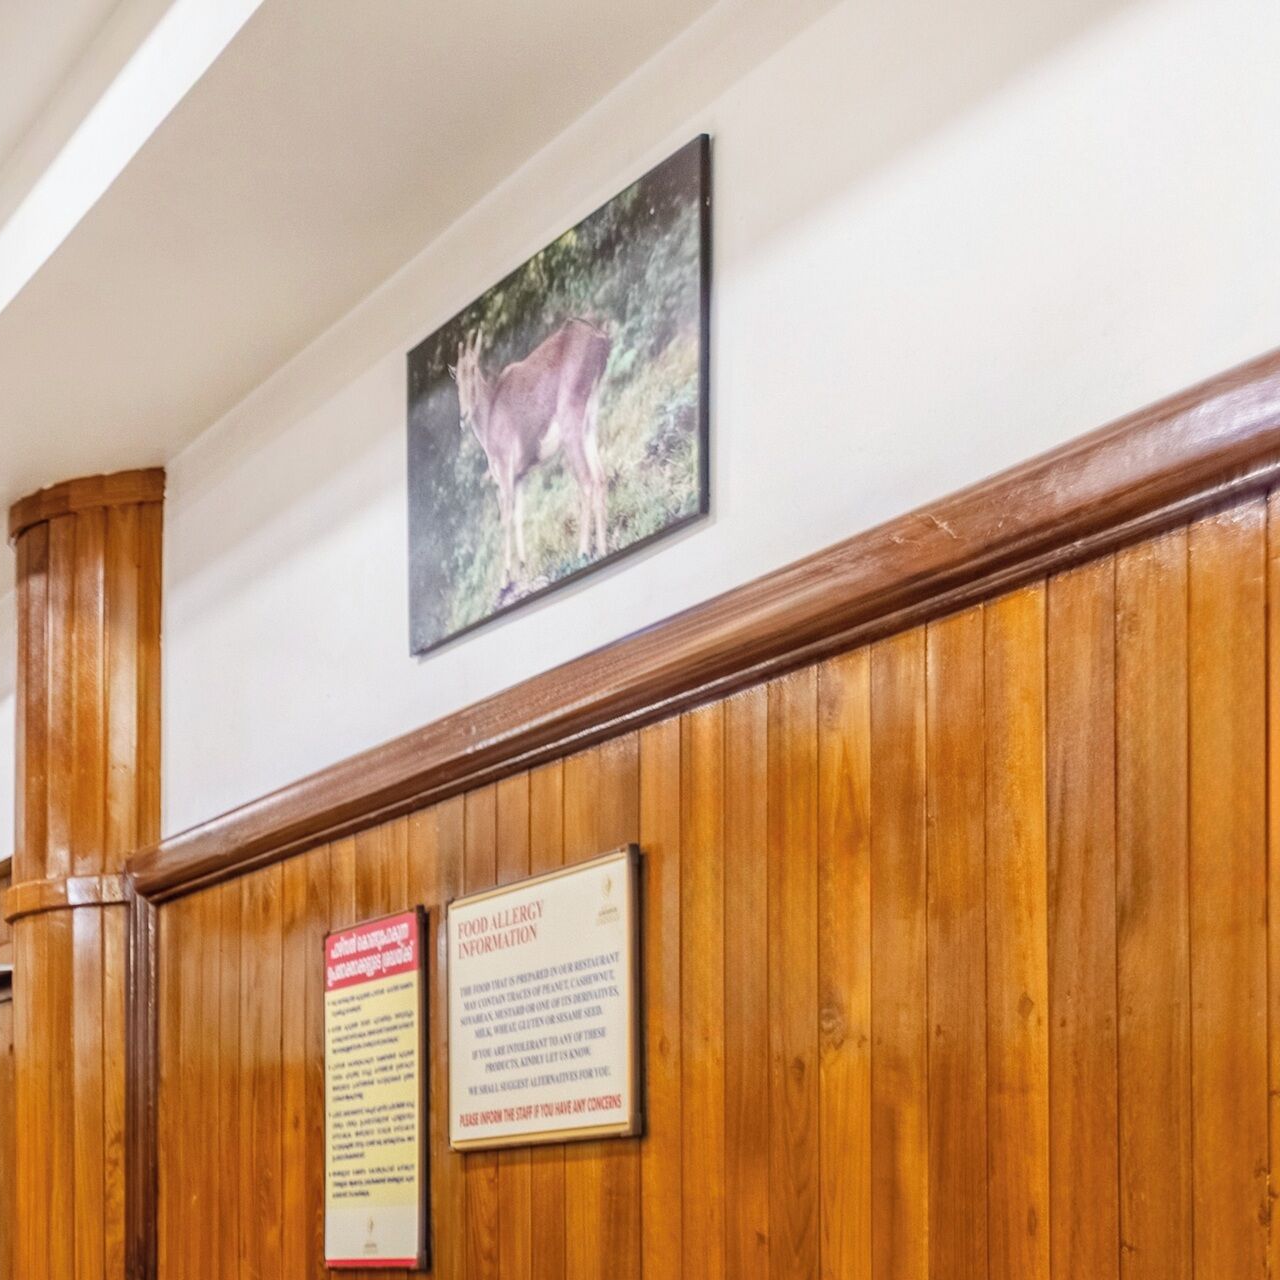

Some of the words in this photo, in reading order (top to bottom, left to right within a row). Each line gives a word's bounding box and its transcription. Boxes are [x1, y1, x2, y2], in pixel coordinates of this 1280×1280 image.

[457, 916, 489, 940] FOOD
[490, 899, 545, 930] ALLERGY
[458, 923, 539, 960] INFORMATION
[460, 985, 471, 996] THE
[474, 981, 490, 993] FOOD
[492, 977, 507, 989] THAT
[509, 975, 515, 985] IS
[516, 968, 549, 983] PREPARED
[550, 966, 557, 976] IN
[559, 962, 573, 974] OUR
[575, 951, 619, 970] RESTAURANT
[464, 1000, 476, 1010] MAY
[478, 994, 505, 1008] CONTAIN
[507, 988, 531, 1001] TRACES
[532, 985, 540, 996] OF
[495, 1005, 524, 1019] MUSTARD
[526, 1002, 535, 1013] OR
[536, 999, 550, 1011] ONE
[551, 997, 560, 1007] OF
[561, 994, 572, 1005] ITS
[518, 1016, 544, 1030] GLUTEN
[545, 1014, 555, 1025] OR
[556, 1008, 583, 1023] SESAME
[472, 1050, 478, 1060] IF
[479, 1047, 491, 1058] YOU
[494, 1044, 505, 1056] ARE
[508, 1037, 547, 1053] INTOLERANT
[549, 1035, 558, 1046] TO
[560, 1032, 572, 1044] ANY
[574, 1030, 583, 1042] OF
[584, 1026, 606, 1040] THESE
[521, 1054, 544, 1067] KINDLY
[546, 1051, 558, 1063] LET
[559, 1049, 568, 1060] US
[468, 1085, 478, 1096] WE
[479, 1082, 499, 1094] SHALL
[500, 1077, 529, 1091] SUGGEST
[530, 1070, 578, 1086] ALTERNATIVES
[579, 1067, 594, 1080] FOR
[460, 1112, 479, 1127] PLEASE
[480, 1109, 503, 1124] INFORM
[504, 1107, 514, 1121] THE
[516, 1105, 532, 1120] STAFF
[533, 1104, 540, 1118] IF
[540, 1102, 554, 1117] YOU
[556, 1100, 571, 1115] HAVE
[573, 1098, 586, 1113] ANY
[588, 1093, 622, 1111] CONCERNS
